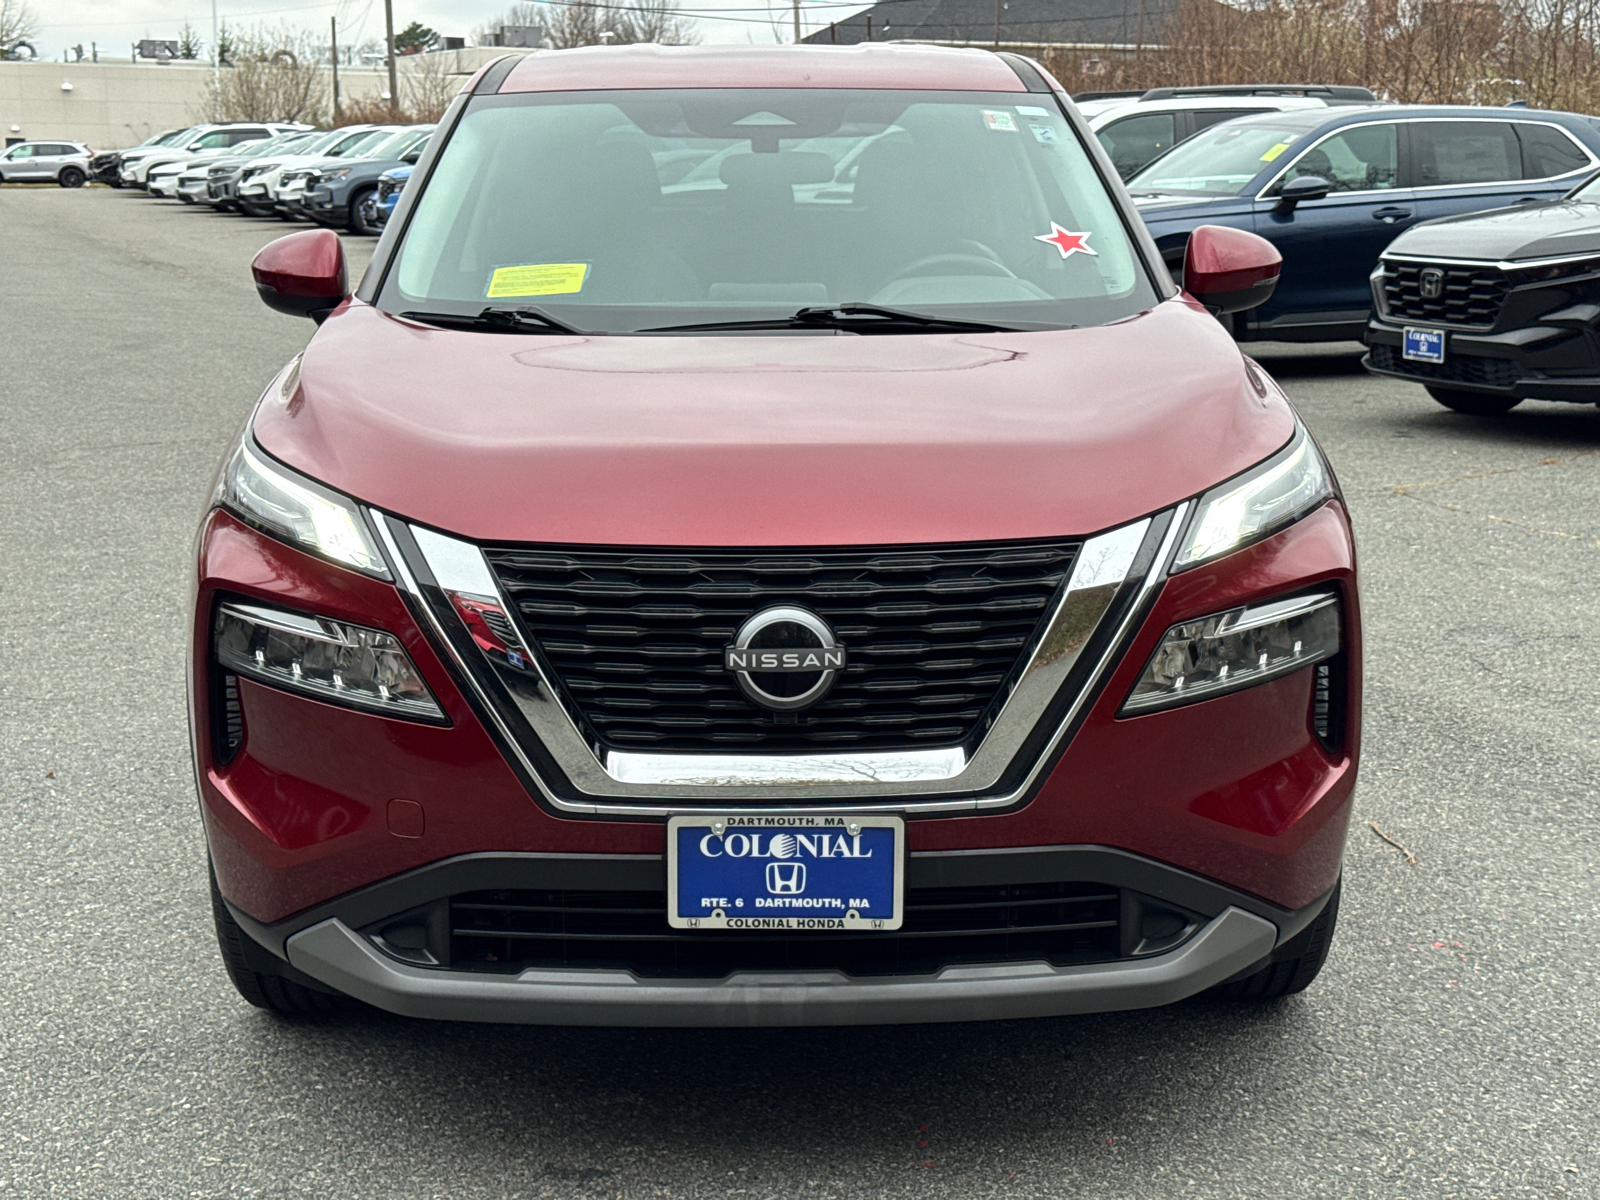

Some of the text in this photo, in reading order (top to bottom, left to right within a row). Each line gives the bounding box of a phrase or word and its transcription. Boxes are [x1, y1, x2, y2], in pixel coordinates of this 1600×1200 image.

[729, 651, 842, 668] NISSAN
[824, 817, 845, 826] MA
[700, 833, 873, 859] COLONIAL
[701, 898, 870, 910] RTE. 6 DARTMOUTH, MA
[726, 919, 845, 928] COLONIAL HONDA
